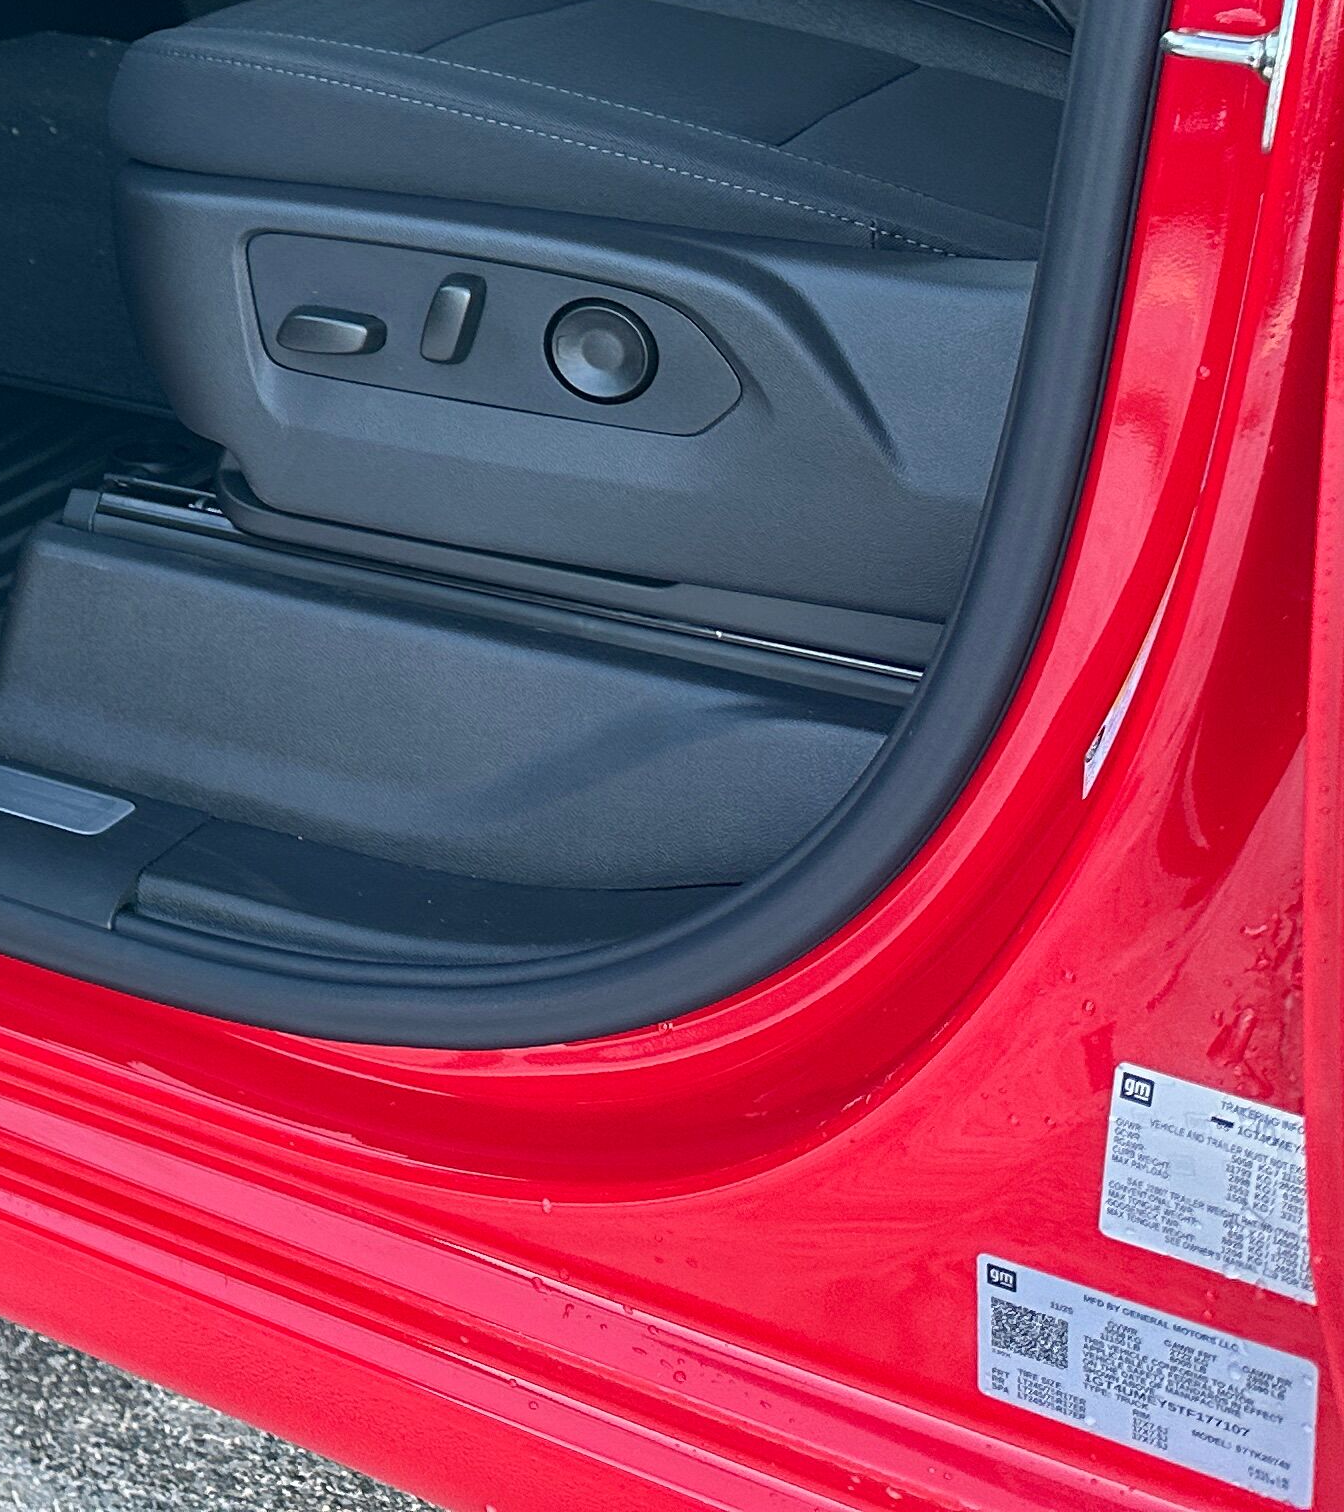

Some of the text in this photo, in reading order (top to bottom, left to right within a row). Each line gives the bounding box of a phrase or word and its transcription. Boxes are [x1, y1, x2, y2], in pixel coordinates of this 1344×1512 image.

[1123, 1077, 1150, 1101] gm
[990, 1268, 1012, 1287] gm
[1122, 1307, 1168, 1329] GENERAL
[1173, 1323, 1216, 1344] MOTORS
[1116, 1393, 1148, 1410] TRUCK
